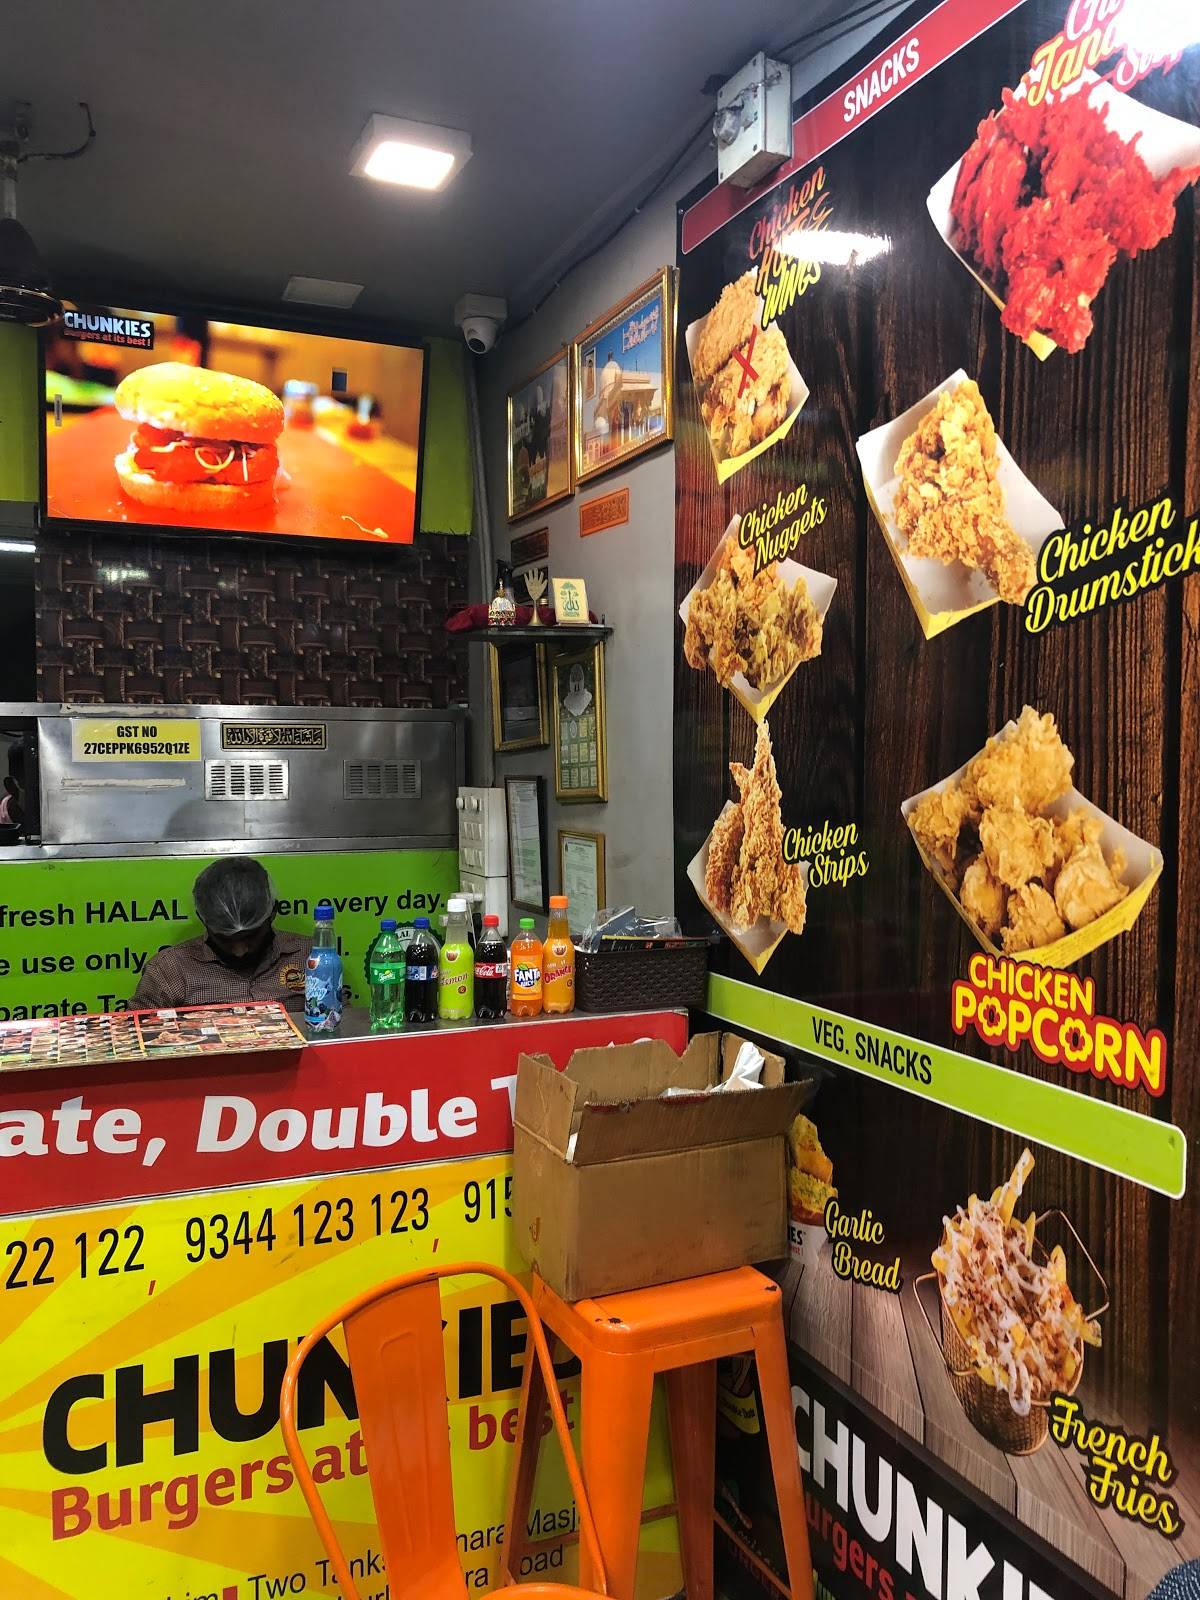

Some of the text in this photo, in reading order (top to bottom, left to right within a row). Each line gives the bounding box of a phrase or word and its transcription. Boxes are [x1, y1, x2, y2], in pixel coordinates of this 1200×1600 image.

[843, 37, 920, 123] SNACKS
[64, 311, 151, 338] CHUNKIES
[126, 336, 146, 347] best
[740, 483, 808, 546] Chicken
[755, 496, 828, 571] Nuggets
[1040, 498, 1176, 583] Chicken
[83, 741, 190, 756] 27CEPPK6952Q1ZE
[116, 725, 157, 738] GST NO
[784, 820, 859, 861] Chicken
[810, 848, 870, 888] Strips
[0, 903, 74, 928] fresh
[86, 899, 188, 925] HALAL
[396, 889, 446, 914] day.
[22, 953, 75, 975] use
[85, 947, 148, 975] only
[514, 968, 541, 982] FANTA
[970, 955, 1093, 1016] CHICKEN
[811, 1016, 933, 1085] VEG. SNACKS
[955, 985, 1161, 1090] POPCORN
[196, 1087, 478, 1153] Double
[186, 1208, 276, 1263] 9344
[293, 1197, 354, 1247] 123
[825, 1200, 885, 1245] Garlic
[833, 1241, 901, 1290] Bread
[43, 1299, 582, 1476] CHUNIE
[1052, 1396, 1173, 1482] French
[51, 1454, 298, 1541] Burgers
[311, 1431, 370, 1485] at
[1089, 1456, 1179, 1535] Fries
[519, 1544, 563, 1577] oad
[805, 1492, 896, 1599] urgers
[248, 1573, 306, 1600] Two
